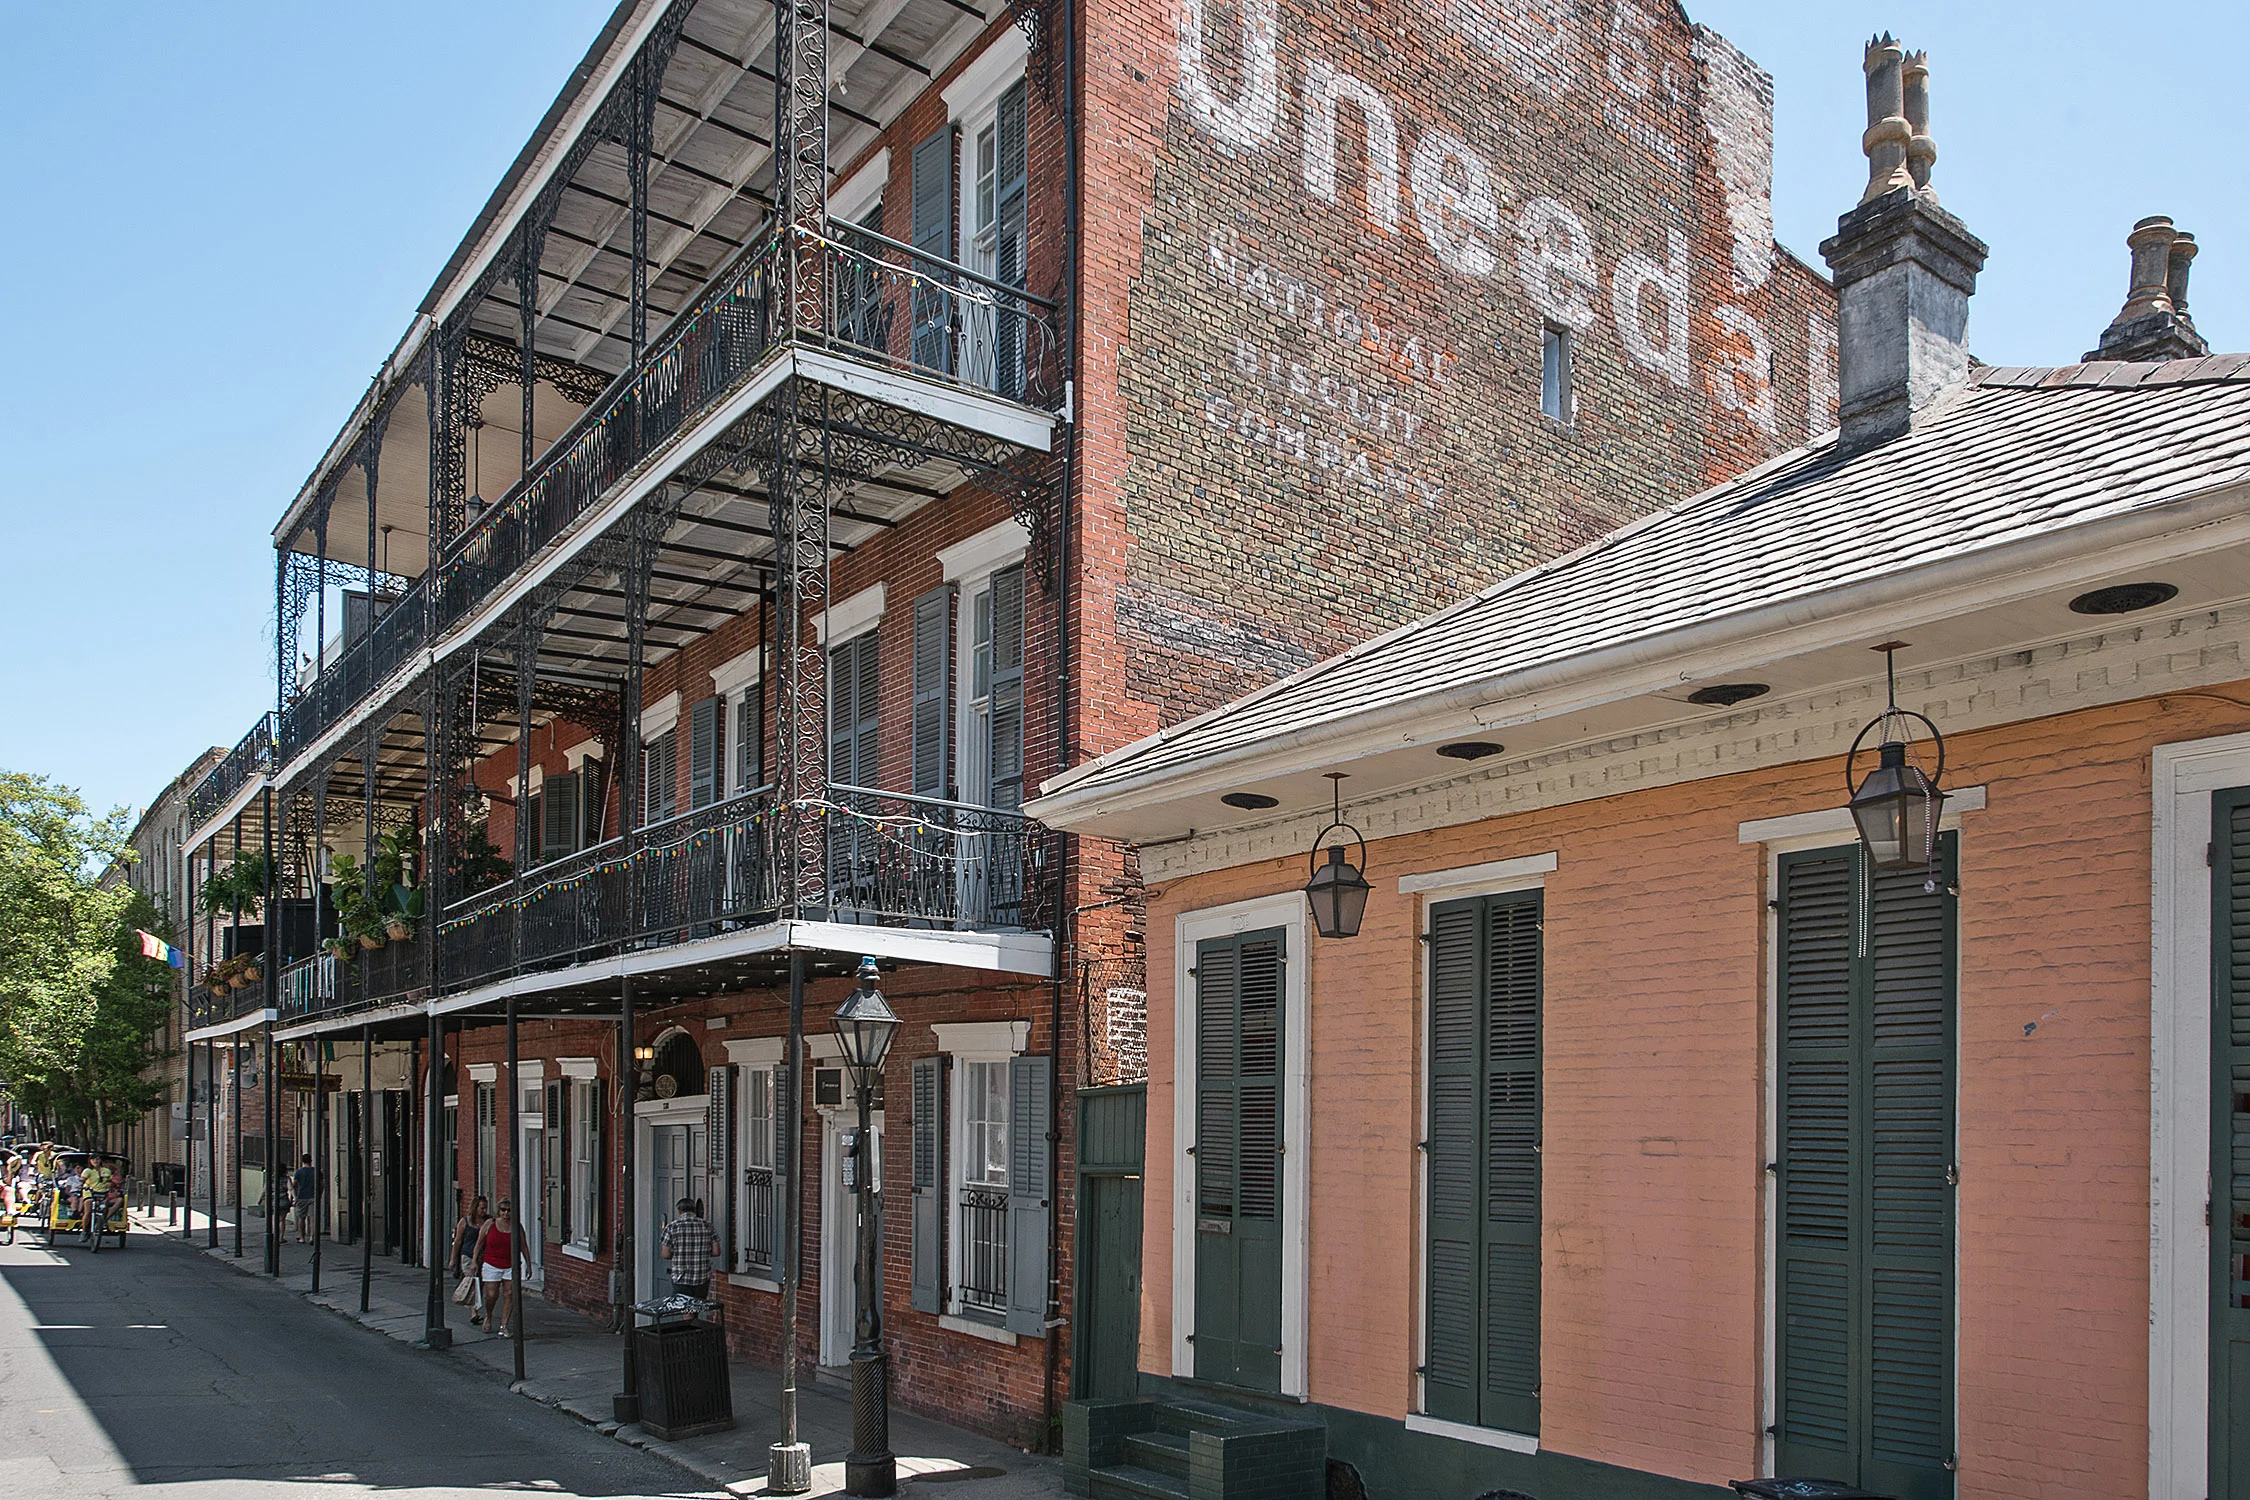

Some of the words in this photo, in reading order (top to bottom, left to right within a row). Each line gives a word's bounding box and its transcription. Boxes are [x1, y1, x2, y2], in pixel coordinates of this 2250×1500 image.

[1208, 227, 1458, 386] NATIONAL
[1232, 337, 1422, 443] BISCUIT
[1204, 394, 1443, 509] COMPANY
